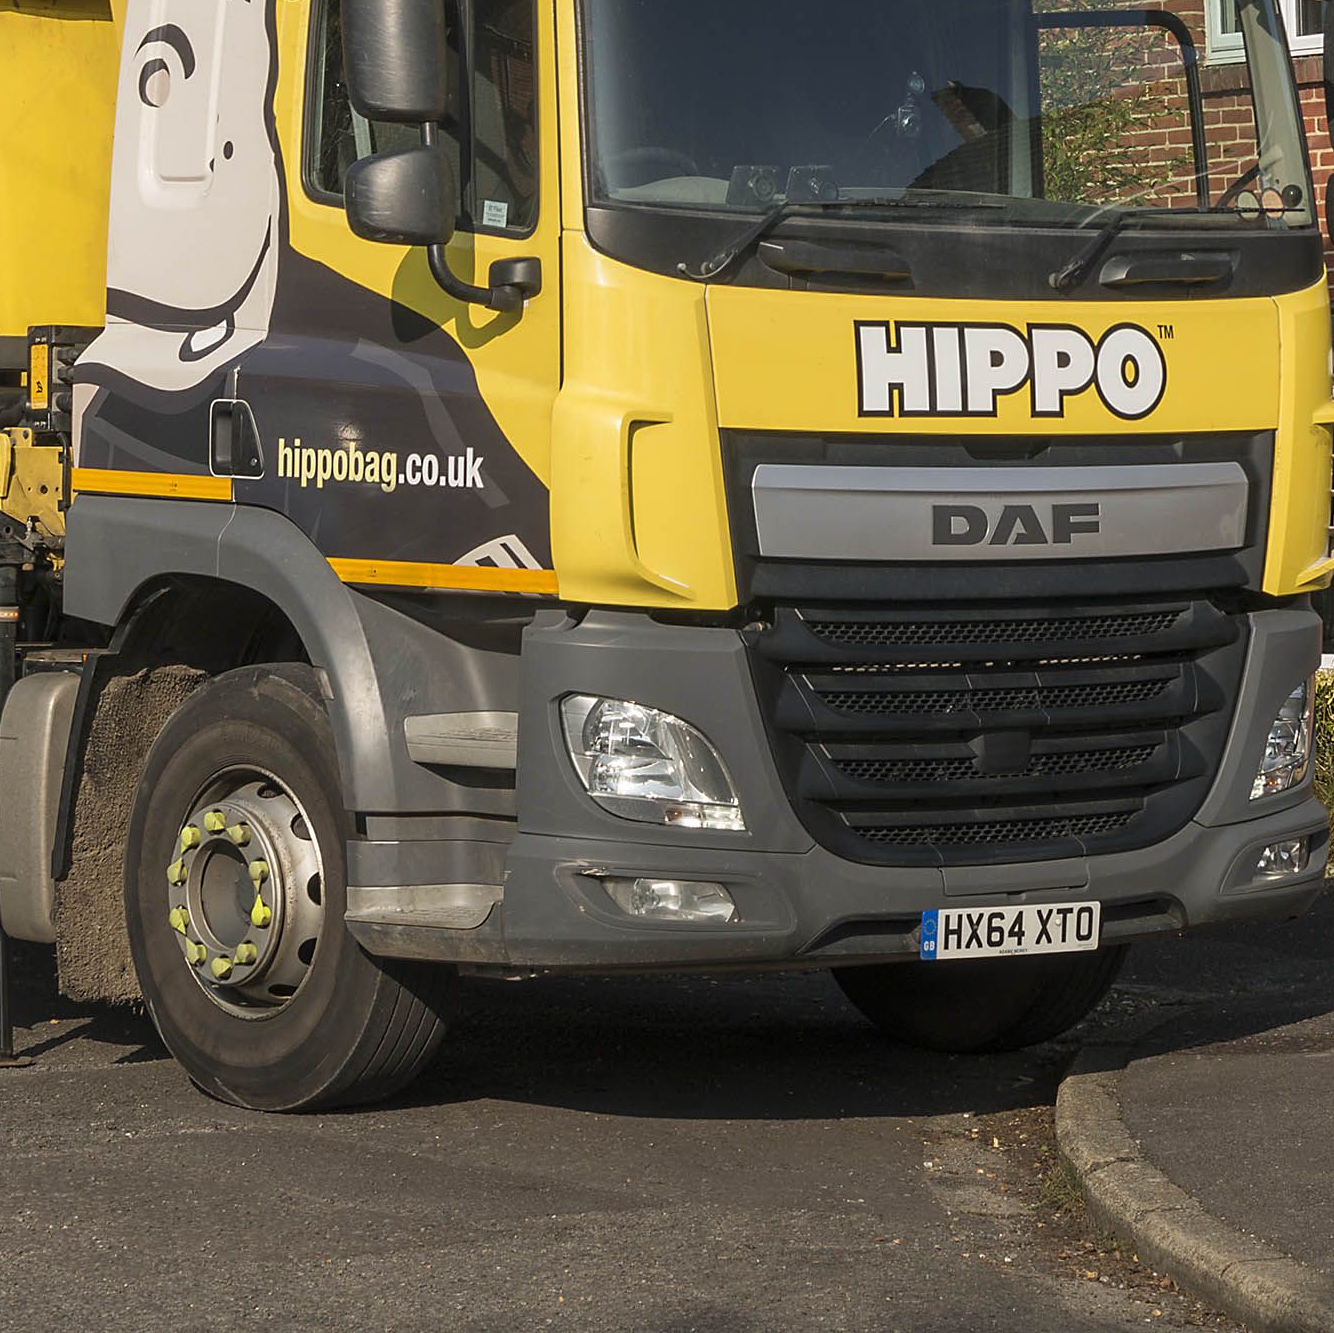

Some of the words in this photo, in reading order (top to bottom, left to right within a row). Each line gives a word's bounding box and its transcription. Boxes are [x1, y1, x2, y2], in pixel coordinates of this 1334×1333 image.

[854, 320, 1167, 421] HIPPO
[277, 437, 485, 493] hippobag.co.uk
[931, 502, 1101, 546] DAF
[923, 940, 935, 952] GB
[943, 910, 1026, 951] HX64
[1034, 905, 1094, 945] XTO
